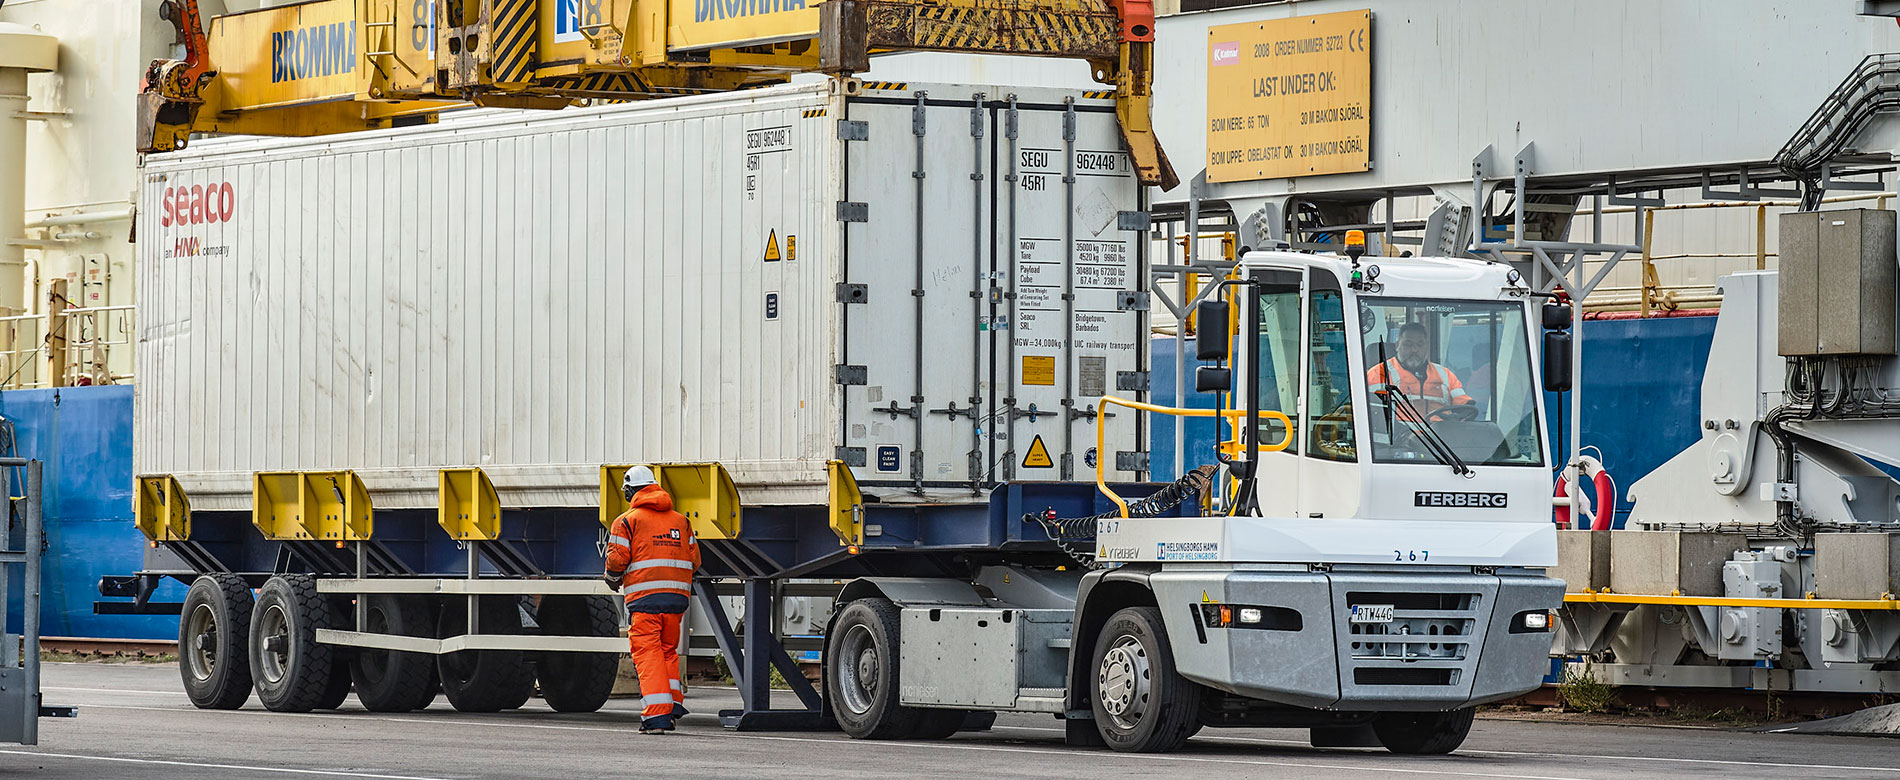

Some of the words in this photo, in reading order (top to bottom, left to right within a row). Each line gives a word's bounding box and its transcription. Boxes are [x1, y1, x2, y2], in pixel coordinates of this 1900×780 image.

[272, 20, 356, 83] BROMMA
[1254, 42, 1270, 58] 2008
[1274, 38, 1296, 57] ORDER
[1297, 37, 1323, 54] NUMMER
[1326, 34, 1343, 51] 52723
[1253, 76, 1278, 98] LAST
[1281, 73, 1315, 96] UNDER
[1318, 71, 1336, 92] OK:
[1300, 112, 1308, 125] 30
[1309, 111, 1314, 124] M
[1315, 109, 1339, 123] BAKOM
[1339, 102, 1364, 121] SJÖRÄL
[1211, 118, 1225, 132] BOM
[1226, 116, 1245, 131] NERE:
[1247, 116, 1254, 129] 65
[1258, 115, 1270, 129] TON
[747, 132, 761, 149] SEGU
[763, 129, 785, 147] 962448
[1300, 145, 1307, 158] 30
[1308, 144, 1314, 157] M
[1315, 142, 1338, 156] BAKOM
[1338, 135, 1363, 154] SJÖRÄL
[747, 154, 760, 171] 45R1
[1021, 151, 1048, 168] SEGU
[1076, 153, 1115, 170] 962448
[1211, 152, 1225, 165] BOM
[1226, 150, 1245, 164] UPPE:
[1247, 146, 1281, 162] OBELASTAT
[1284, 145, 1293, 159] OK
[1021, 175, 1046, 191] 45R1
[161, 181, 234, 228] seaco
[165, 249, 172, 259] an
[202, 245, 230, 258] company
[1020, 241, 1036, 250] MGW
[1076, 243, 1092, 252] 35000
[1092, 243, 1099, 253] kg
[1118, 244, 1126, 253] lbs
[1079, 253, 1092, 261] 4520
[1092, 253, 1099, 263] kg
[1118, 254, 1126, 262] lbs
[1020, 265, 1041, 275] Payload
[1092, 267, 1099, 277] kg
[1100, 267, 1117, 276] 67200
[1118, 268, 1126, 276] lbs
[1020, 274, 1033, 283] Cube
[1020, 312, 1036, 321] Seaco
[1075, 313, 1107, 323] Bridgetown,
[1075, 323, 1099, 332] Barbados
[1074, 340, 1084, 349] UIC
[1086, 340, 1107, 350] railway
[1109, 341, 1135, 352] transport
[1417, 493, 1506, 507] TERBERG
[1166, 542, 1202, 552] HELSINGBORGS
[1203, 542, 1218, 551] HAMN
[1166, 552, 1178, 560] PORT
[1179, 552, 1184, 560] OF
[1185, 552, 1218, 560] HELSINGBORG
[1357, 607, 1392, 621] RTW44G
